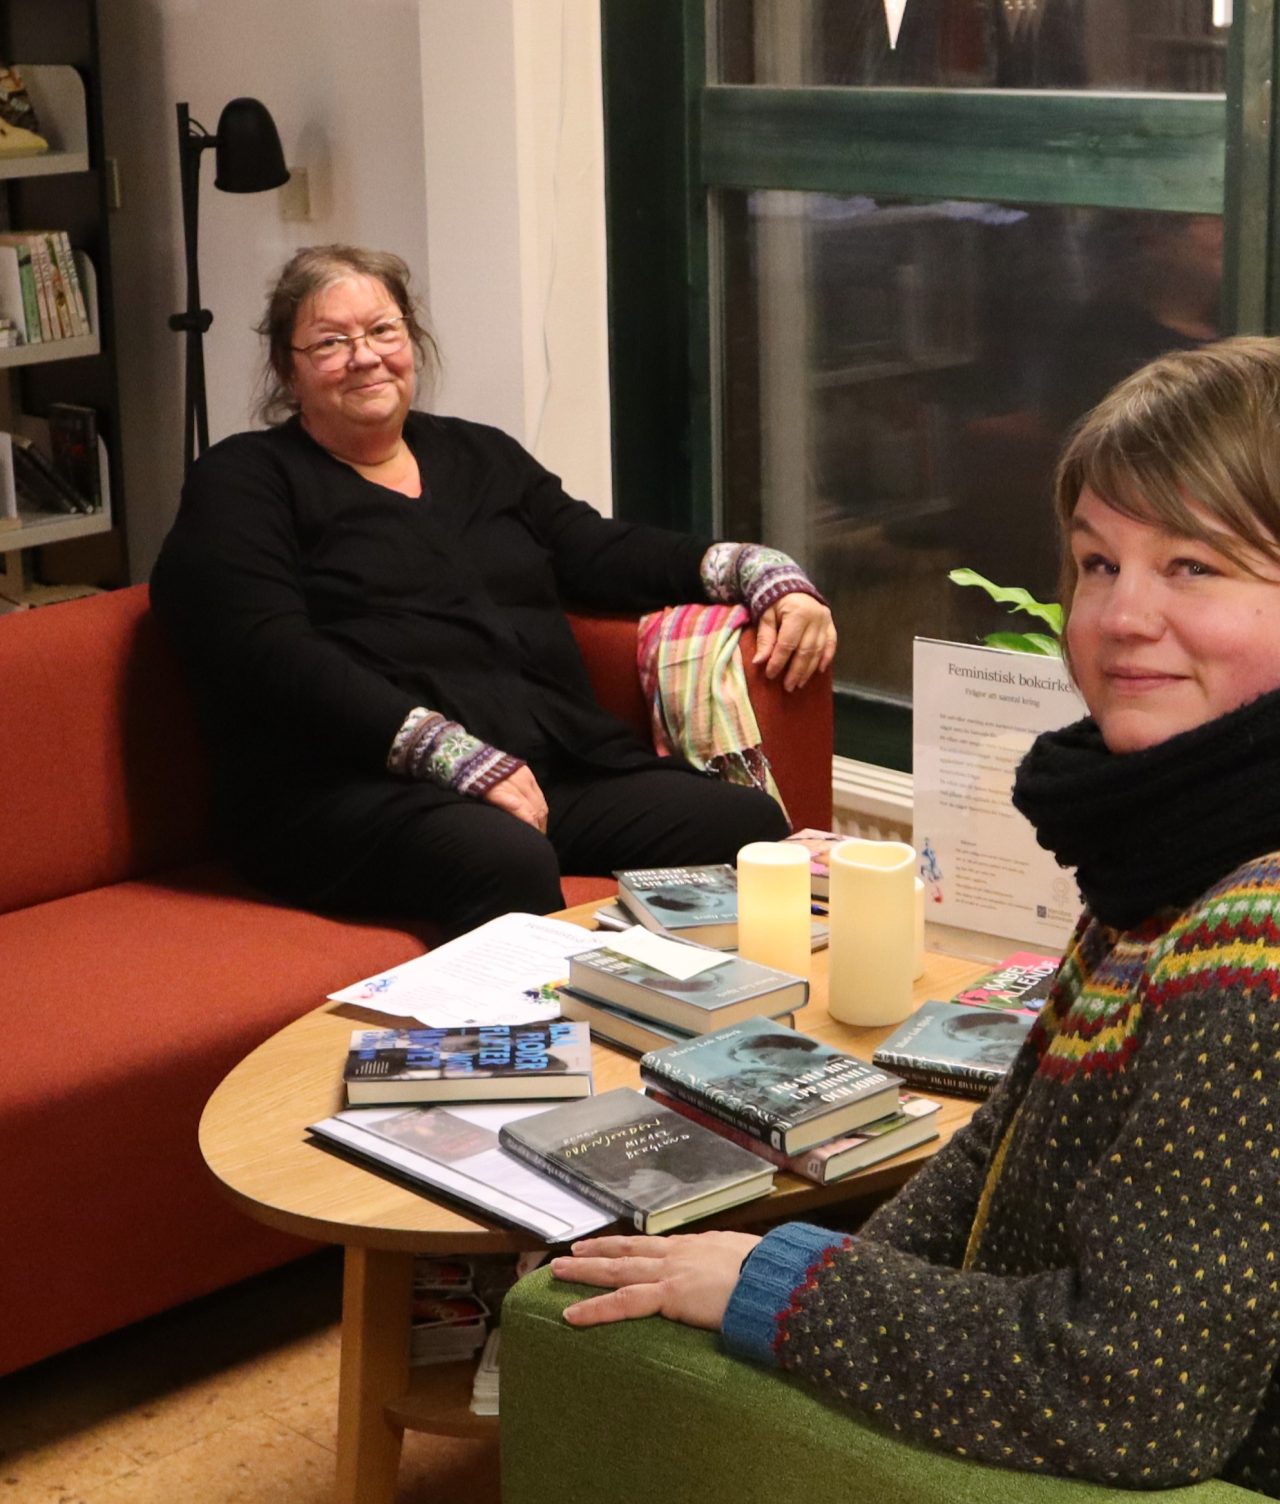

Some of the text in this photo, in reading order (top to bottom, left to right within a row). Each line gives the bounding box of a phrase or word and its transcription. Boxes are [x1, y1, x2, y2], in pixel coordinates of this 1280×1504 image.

[948, 663, 1075, 693] Feministisk bokcirke
[997, 960, 1058, 1004] ALLENDE
[479, 1024, 511, 1066] FLYTER
[515, 1030, 550, 1071] FLODER
[770, 1059, 858, 1095] JAG VILL RIVA
[789, 1066, 871, 1101] UPP HIMMEL
[820, 1086, 854, 1103] OCH
[851, 1073, 888, 1091] JORD
[625, 1130, 671, 1149] MIKAEL
